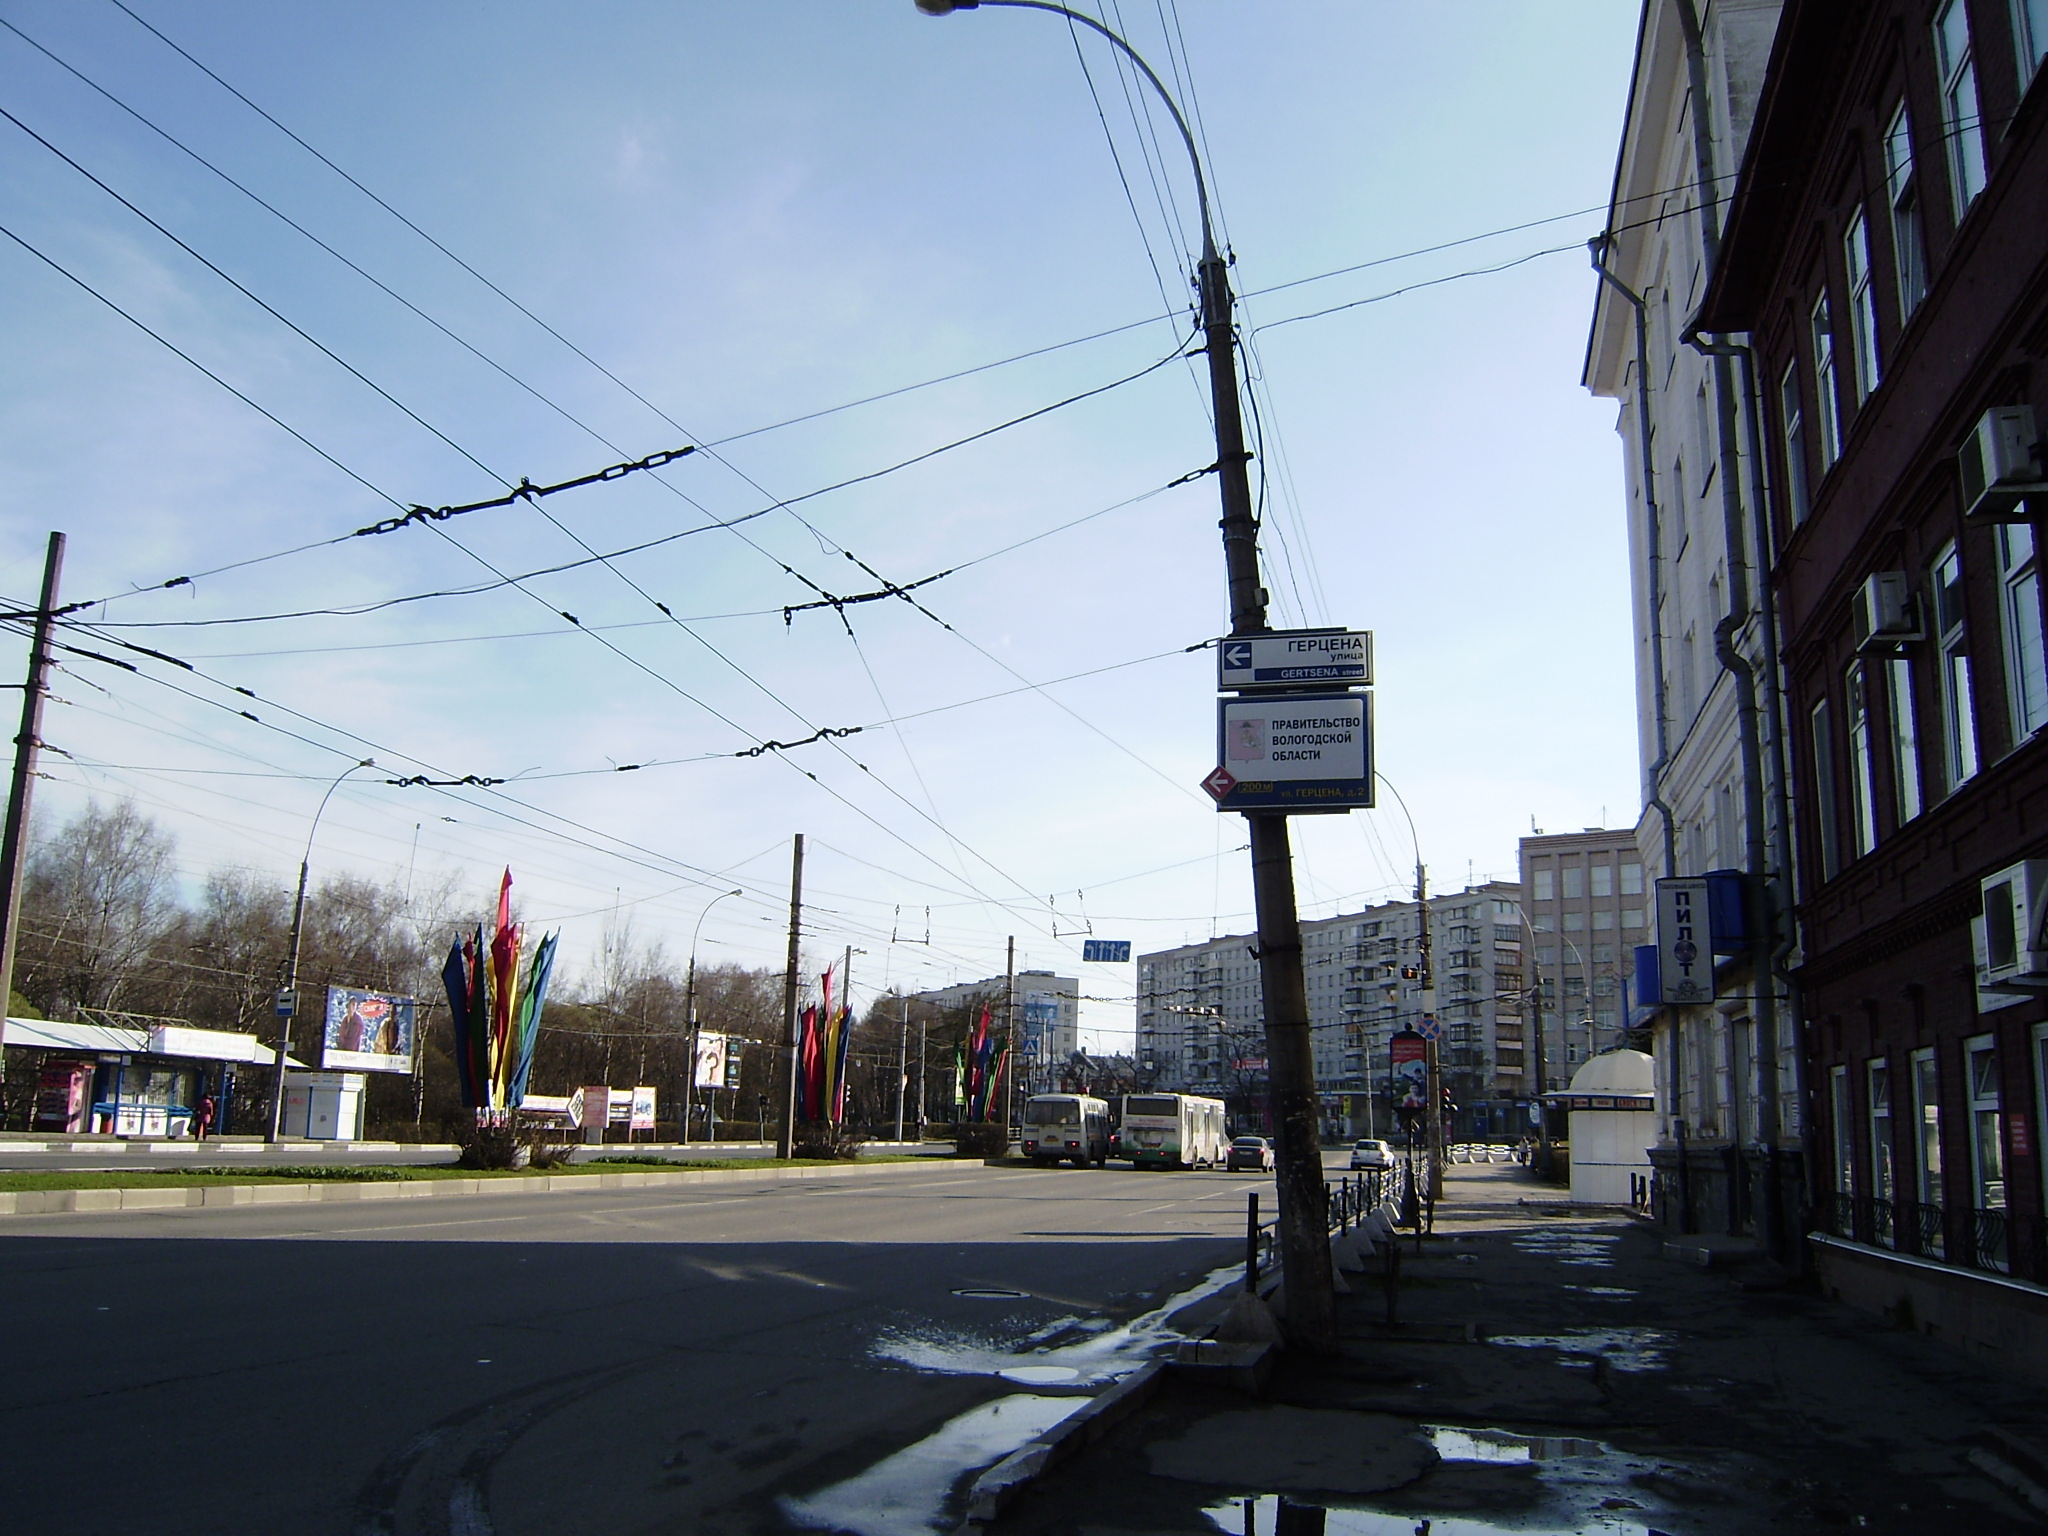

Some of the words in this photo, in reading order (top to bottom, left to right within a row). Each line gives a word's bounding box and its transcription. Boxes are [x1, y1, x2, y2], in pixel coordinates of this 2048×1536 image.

[1288, 638, 1362, 652] ГЕРЦЕНА
[1330, 652, 1364, 662] улица
[1281, 667, 1338, 678] GERTSENA
[1341, 668, 1364, 676] street
[1272, 717, 1360, 730] ПРАВИТЕЛЬСТВО
[1272, 730, 1351, 746] ВОЛОГОДСКОЙ
[1272, 750, 1321, 761] ОБЛАСТИ
[1242, 782, 1262, 792] 200
[1296, 787, 1344, 798] ГЕРЦЕНА,
[1357, 787, 1364, 796] 2
[1674, 891, 1698, 977] ПИЛОТ
